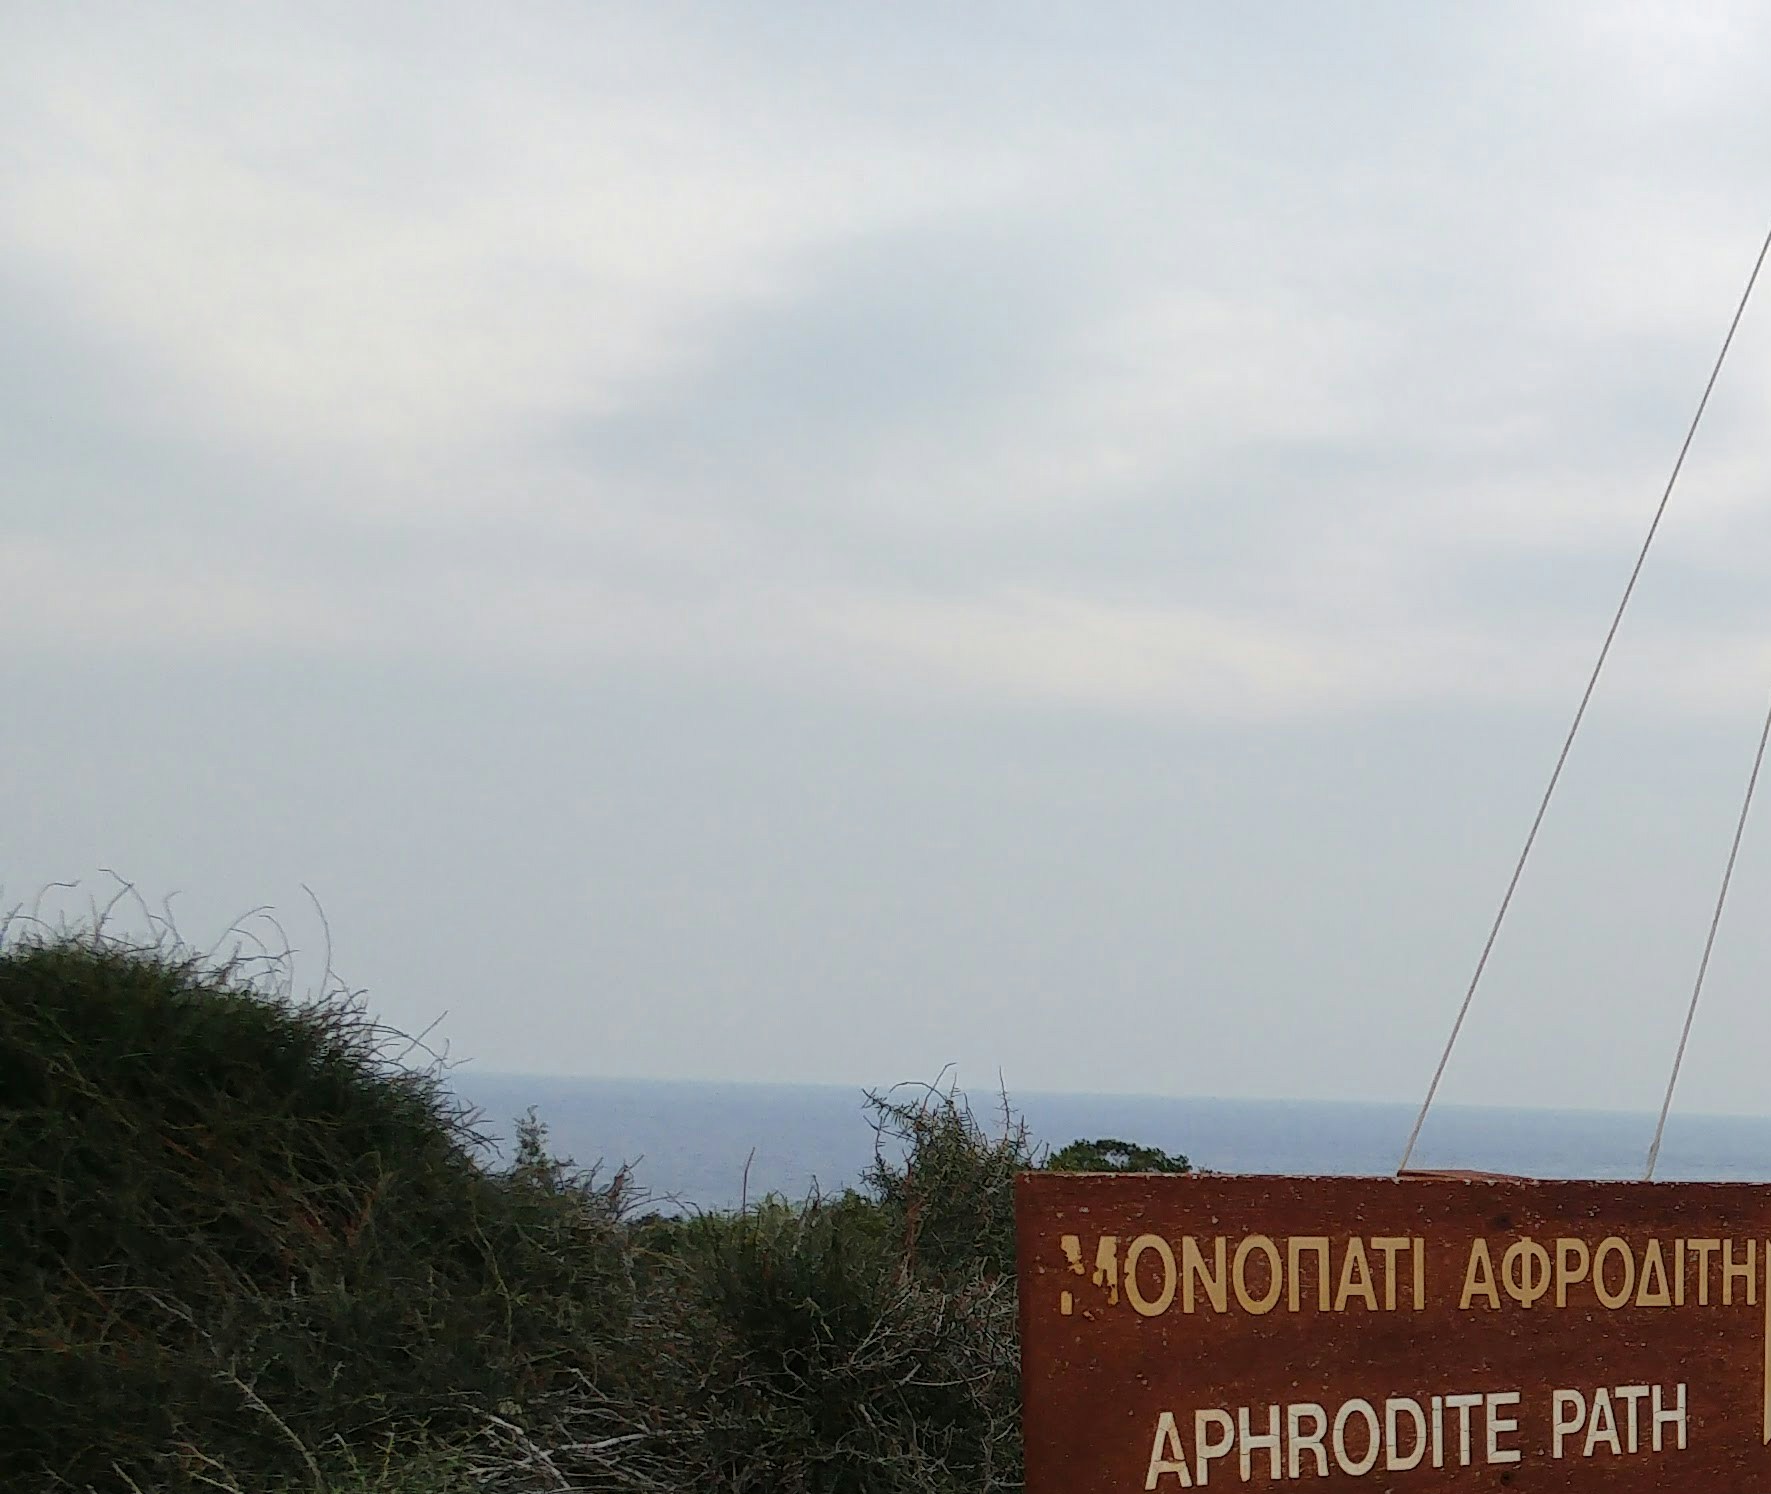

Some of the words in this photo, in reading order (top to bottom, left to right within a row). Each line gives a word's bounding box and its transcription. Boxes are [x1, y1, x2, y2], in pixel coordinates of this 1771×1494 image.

[1459, 1236, 1758, 1310] ΑΦΡΟΔΙΤΗ
[1144, 1392, 1521, 1491] APHRODITE
[1552, 1383, 1688, 1459] PATH
